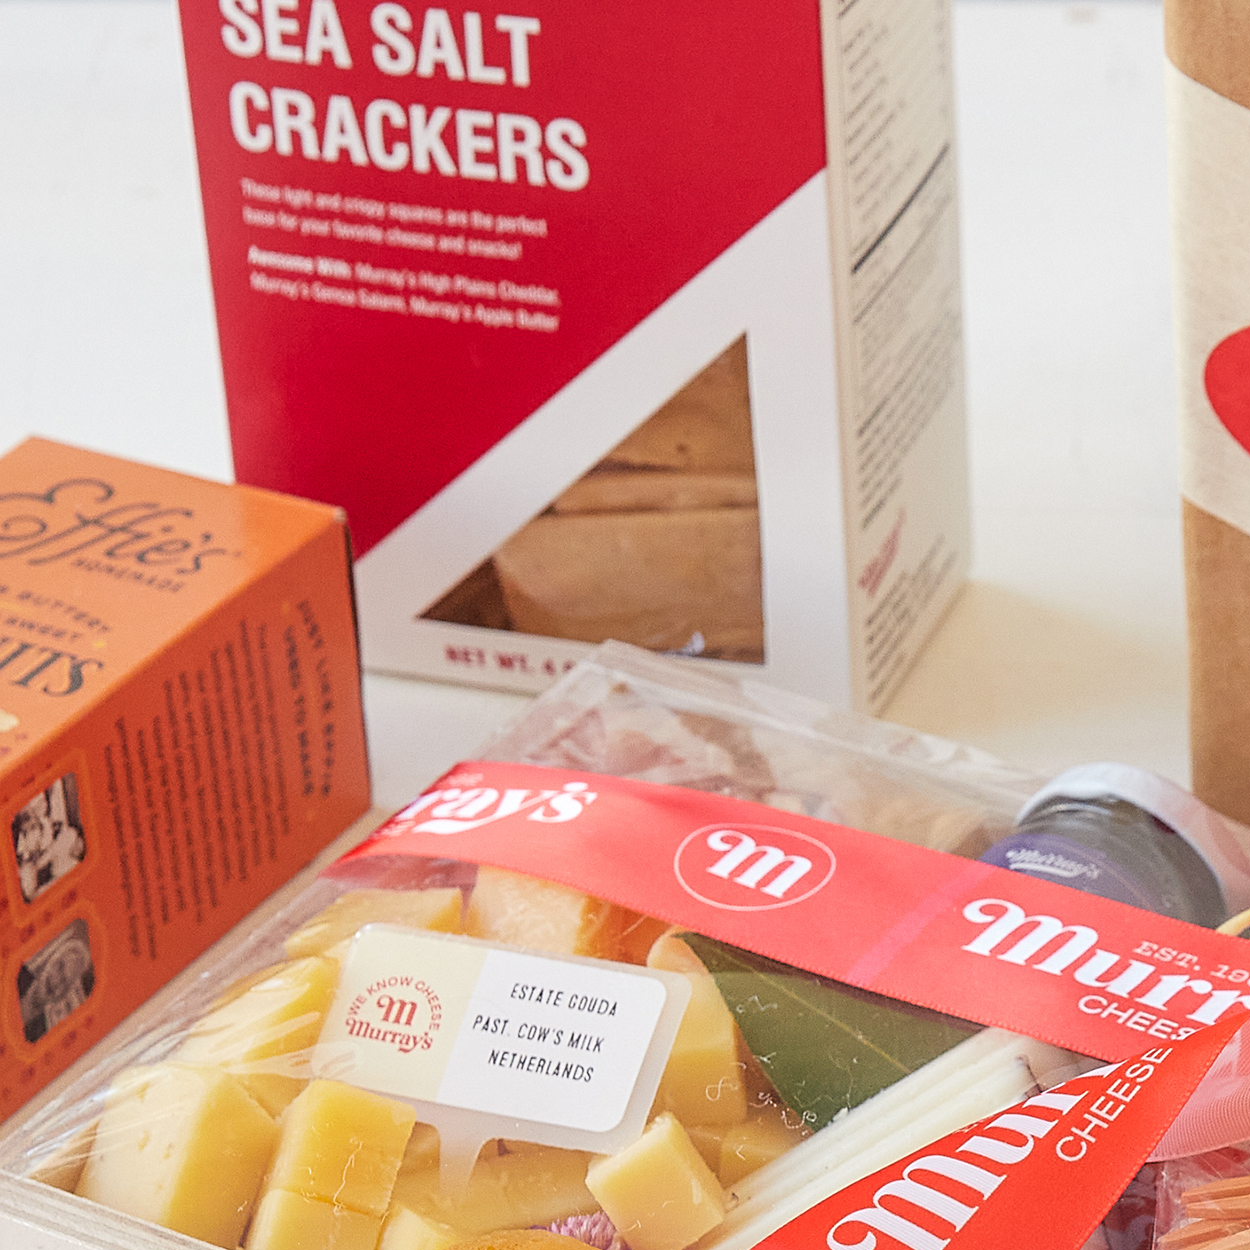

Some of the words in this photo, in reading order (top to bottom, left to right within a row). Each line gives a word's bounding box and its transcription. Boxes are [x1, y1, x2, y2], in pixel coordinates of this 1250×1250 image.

[218, 0, 353, 70] SEA
[369, 1, 541, 89] SALT
[228, 79, 590, 192] CRACKERS
[396, 781, 598, 835] ray's
[1133, 939, 1201, 974] EST.
[366, 976, 414, 996] KNOW
[415, 980, 442, 1032] CHEESE
[510, 983, 563, 1007] ESTATE
[568, 993, 619, 1017] GOUDA
[1078, 994, 1196, 1042] CHEES
[345, 1016, 433, 1053] Murray's
[472, 1015, 510, 1038] PAST.
[518, 1023, 565, 1046] COW'S
[567, 1032, 605, 1053] MILK
[488, 1050, 595, 1083] NETHERLANDS
[1055, 1047, 1173, 1163] CHEESE
